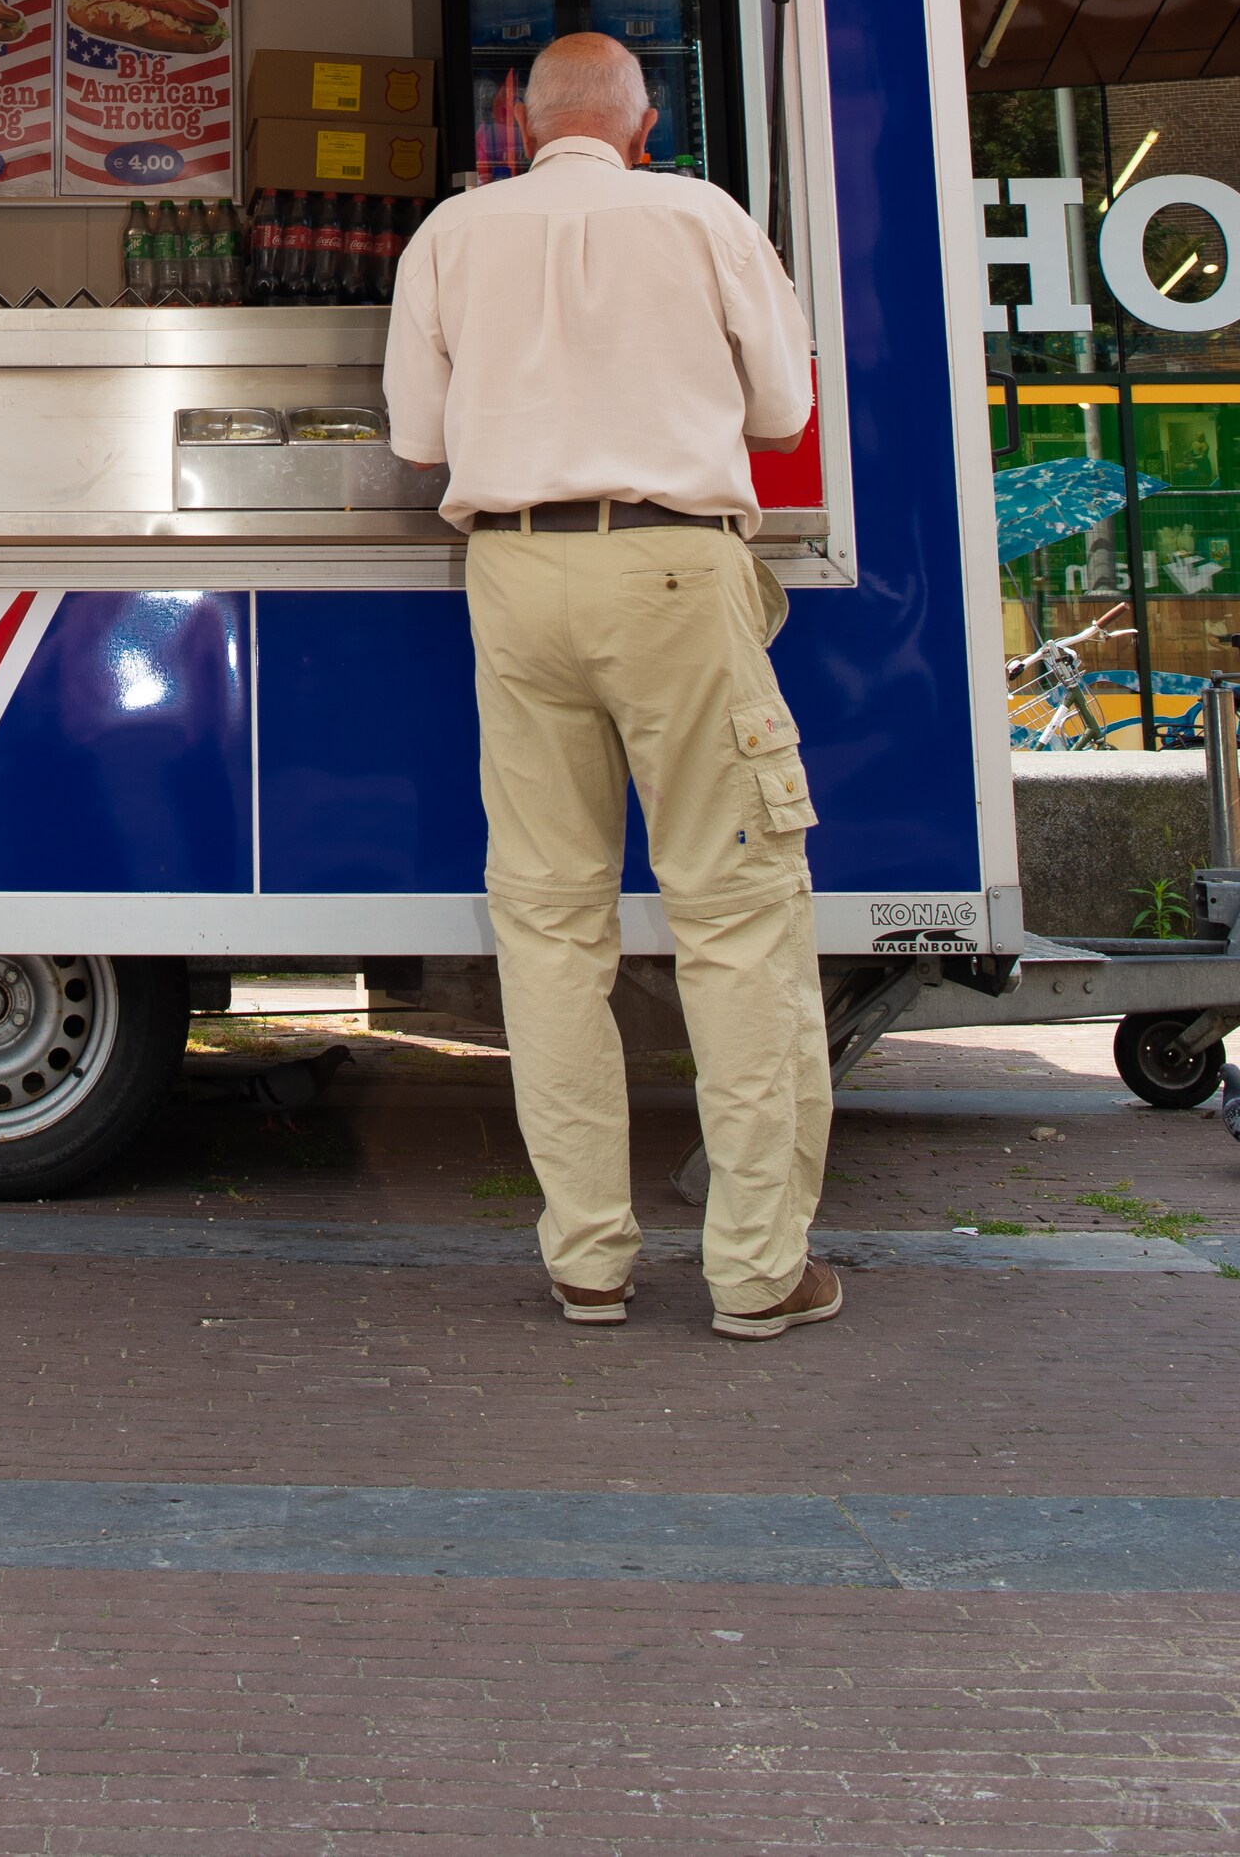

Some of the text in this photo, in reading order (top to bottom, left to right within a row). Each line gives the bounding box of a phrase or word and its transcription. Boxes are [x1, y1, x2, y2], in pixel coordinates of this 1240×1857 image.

[117, 54, 167, 84] Big
[80, 80, 216, 106] American
[103, 106, 203, 137] Hotdog
[127, 155, 175, 173] 4,00
[870, 901, 977, 926] KONAG
[872, 942, 978, 953] WAGENBOUW
